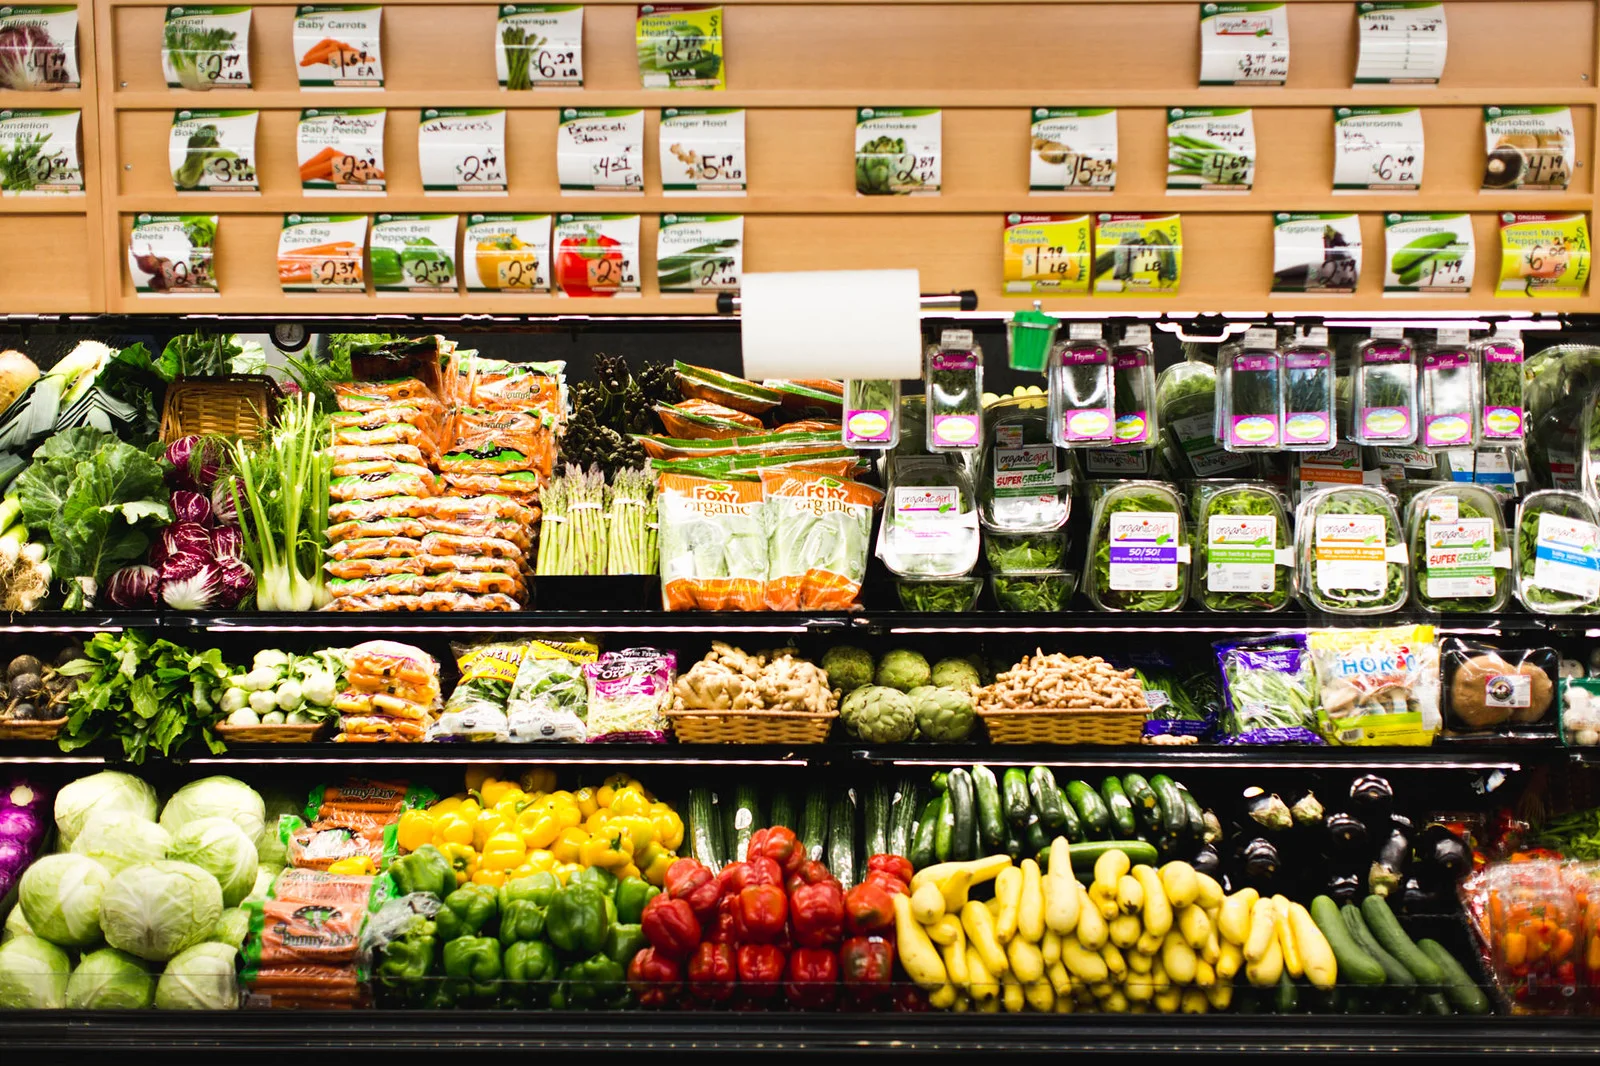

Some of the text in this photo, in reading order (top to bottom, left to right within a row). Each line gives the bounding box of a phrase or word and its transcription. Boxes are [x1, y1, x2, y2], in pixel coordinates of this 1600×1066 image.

[298, 21, 366, 30] Baby Carrots
[502, 17, 558, 26] Asparagus
[358, 66, 374, 76] EA
[229, 72, 243, 80] LB
[664, 120, 698, 128] Ginger
[1036, 123, 1078, 131] Tumeric
[1173, 122, 1203, 130] Green
[302, 125, 366, 134] Baby Peeled
[60, 172, 74, 180] EA
[238, 173, 254, 181] LB
[365, 172, 378, 180] EA
[488, 173, 501, 181] EA
[725, 171, 742, 179] LB
[1400, 173, 1413, 181] EA
[625, 174, 642, 186] EA
[135, 232, 164, 240] Beets
[310, 229, 330, 238] Bag
[663, 228, 702, 236] English
[284, 236, 322, 244] Carrots
[375, 234, 417, 243] Peppers
[1050, 262, 1068, 274] LB
[1145, 261, 1161, 272] LB
[530, 277, 544, 285] LB
[1074, 353, 1095, 363] Thyme
[997, 476, 1022, 486] SUPER
[696, 488, 737, 502] FOXY
[807, 485, 848, 501] FOXY
[684, 500, 750, 516] organic
[1129, 548, 1161, 557] 50/50!
[1430, 554, 1457, 565] SUPER
